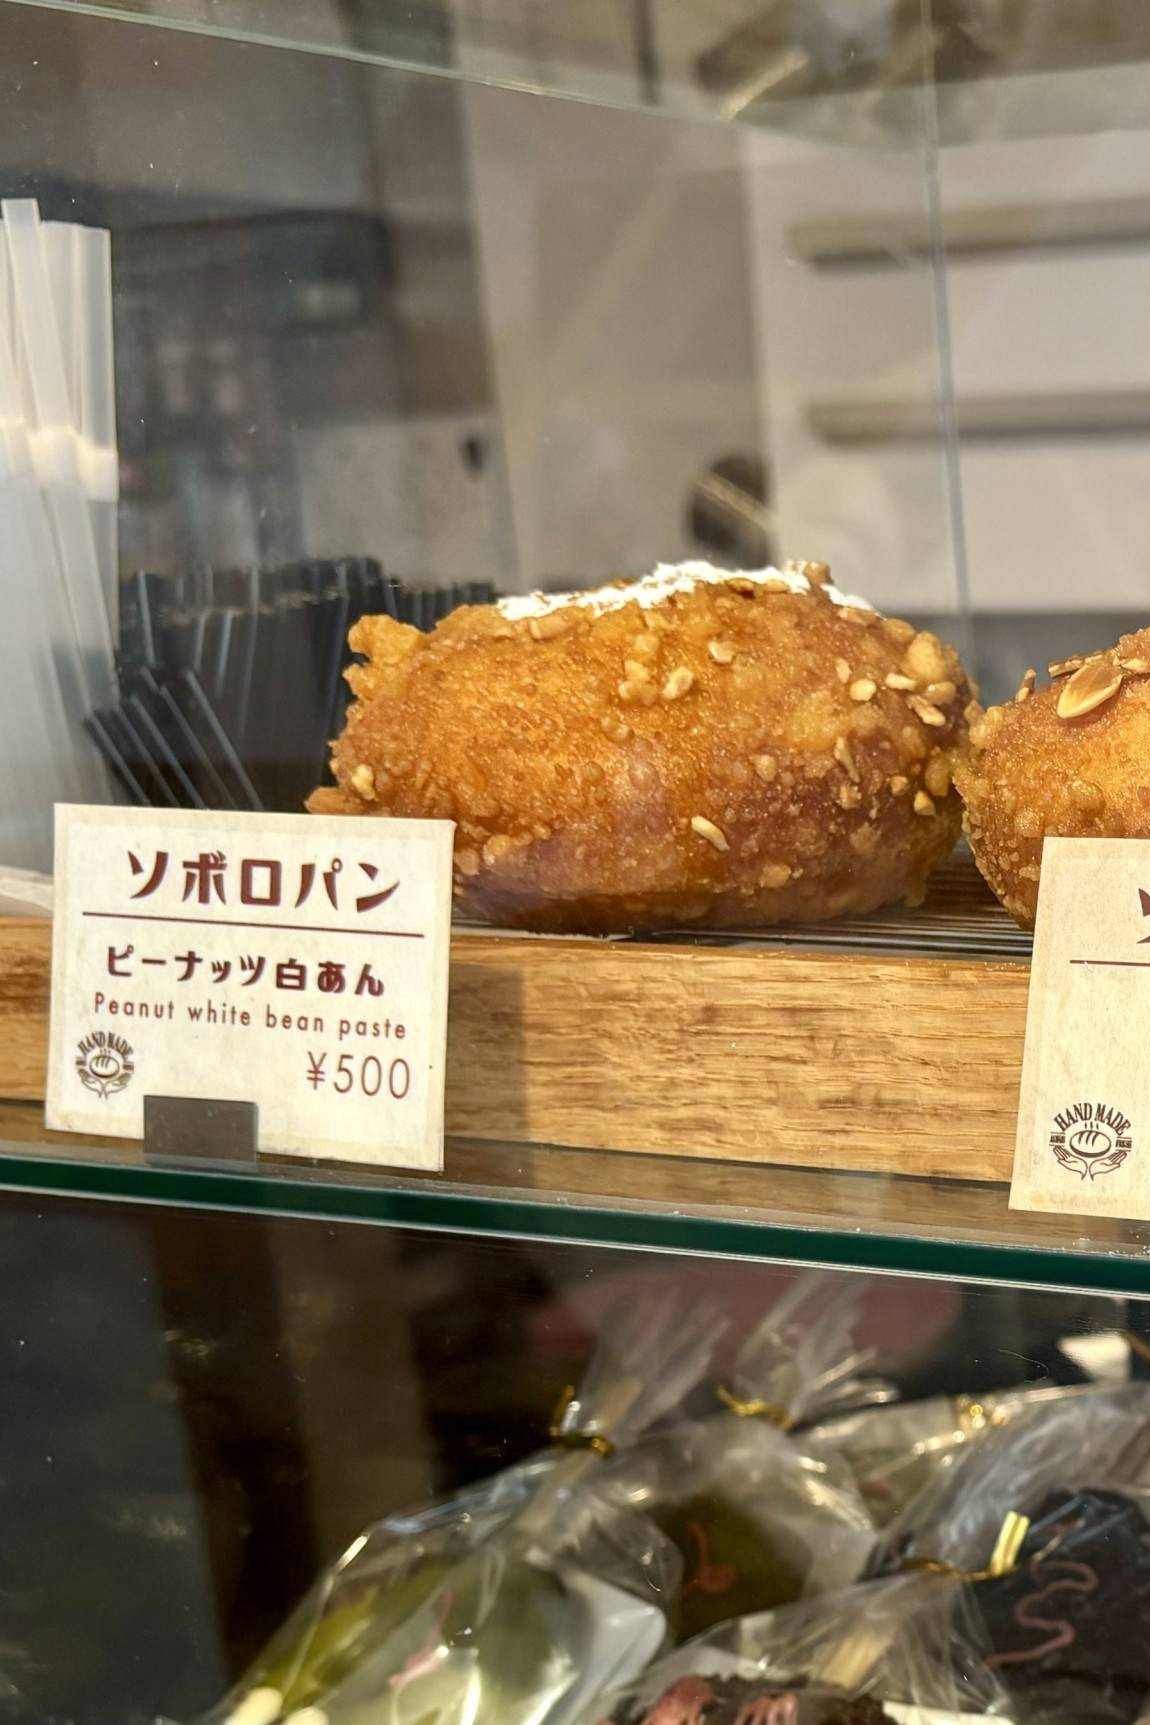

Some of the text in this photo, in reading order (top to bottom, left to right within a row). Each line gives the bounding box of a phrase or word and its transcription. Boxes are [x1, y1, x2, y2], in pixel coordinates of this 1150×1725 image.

[128, 850, 401, 914] ソボロパン
[107, 944, 385, 998] ピーナッツ白あん
[94, 992, 407, 1041] Peanut white bean paste
[307, 1051, 411, 1100] ¥500
[1053, 1102, 1132, 1136] HAND MADE
